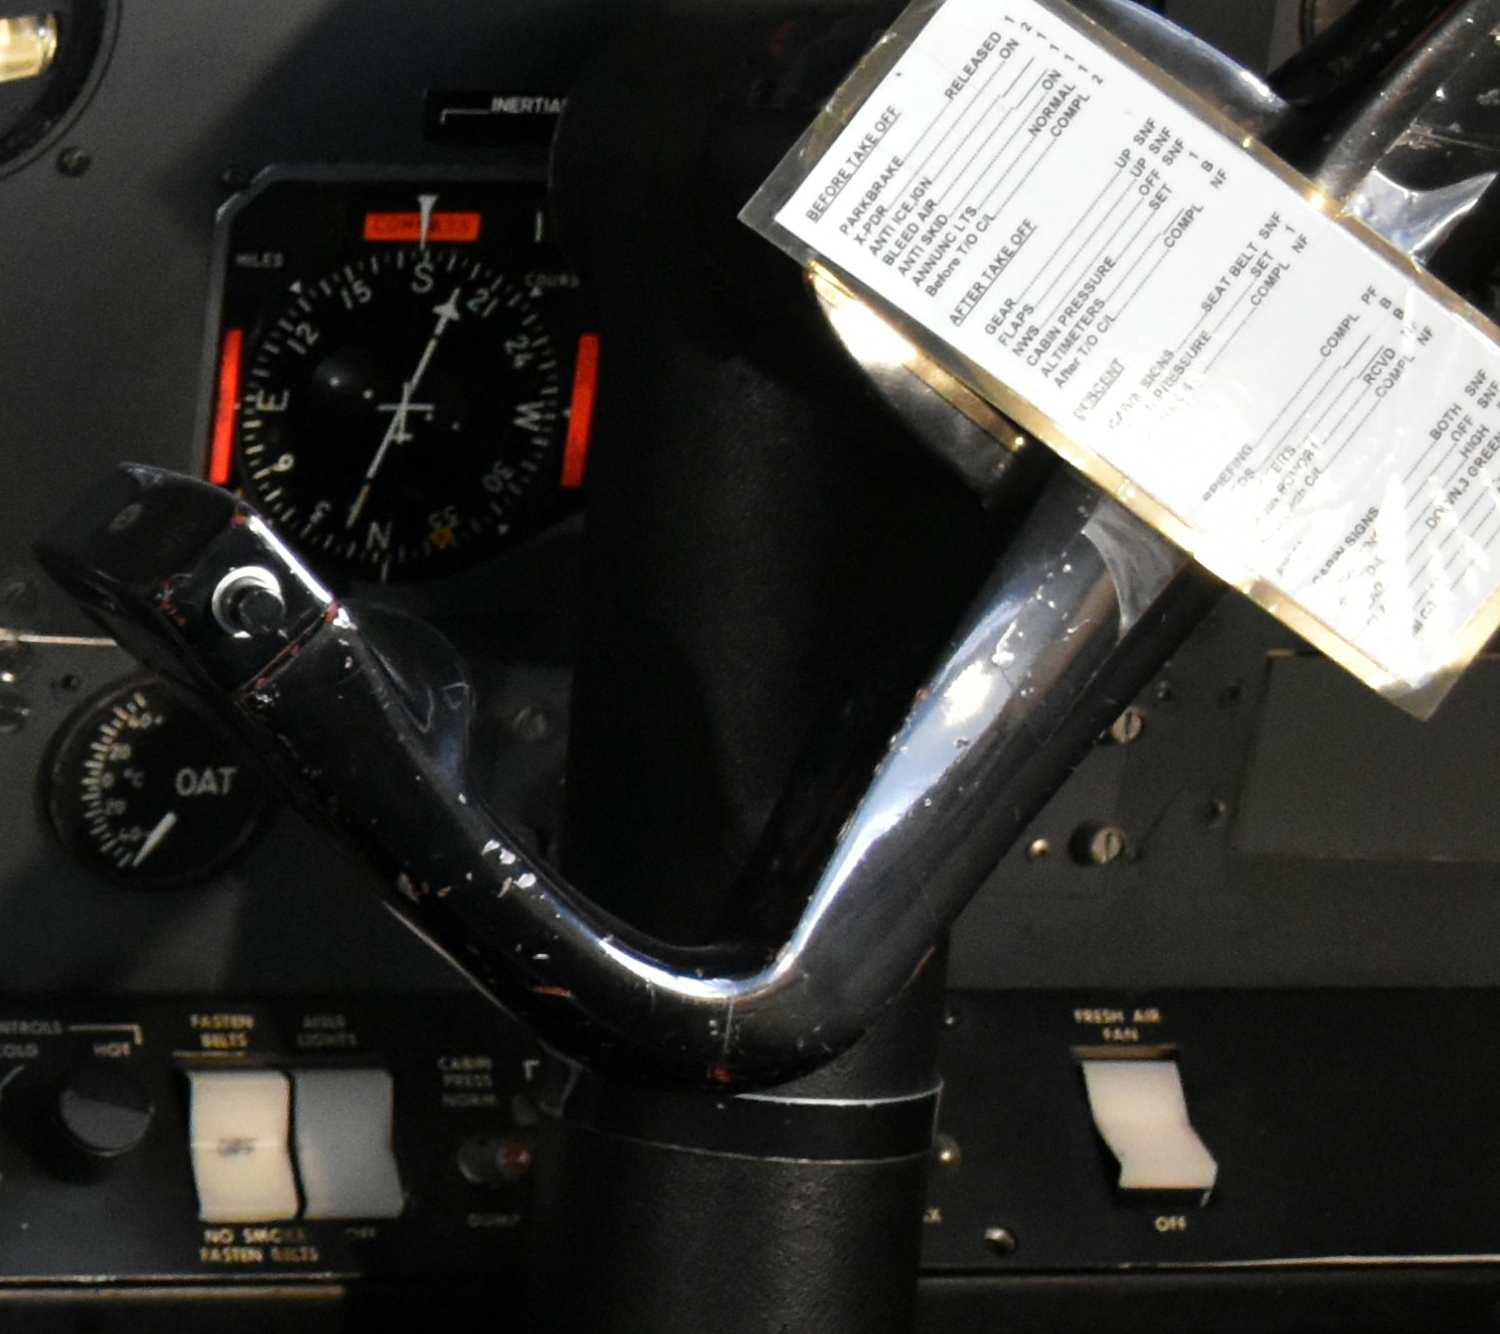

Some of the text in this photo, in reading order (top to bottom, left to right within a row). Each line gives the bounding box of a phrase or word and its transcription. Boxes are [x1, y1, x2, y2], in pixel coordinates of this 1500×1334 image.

[944, 31, 1002, 100] RELEASED
[1028, 81, 1076, 137] NORMAL
[805, 104, 901, 223] BEFORE TAKE OFF
[839, 155, 905, 236] PARKBRAKE
[1041, 298, 1106, 378] ALTIMETERS
[175, 767, 237, 797] OAT
